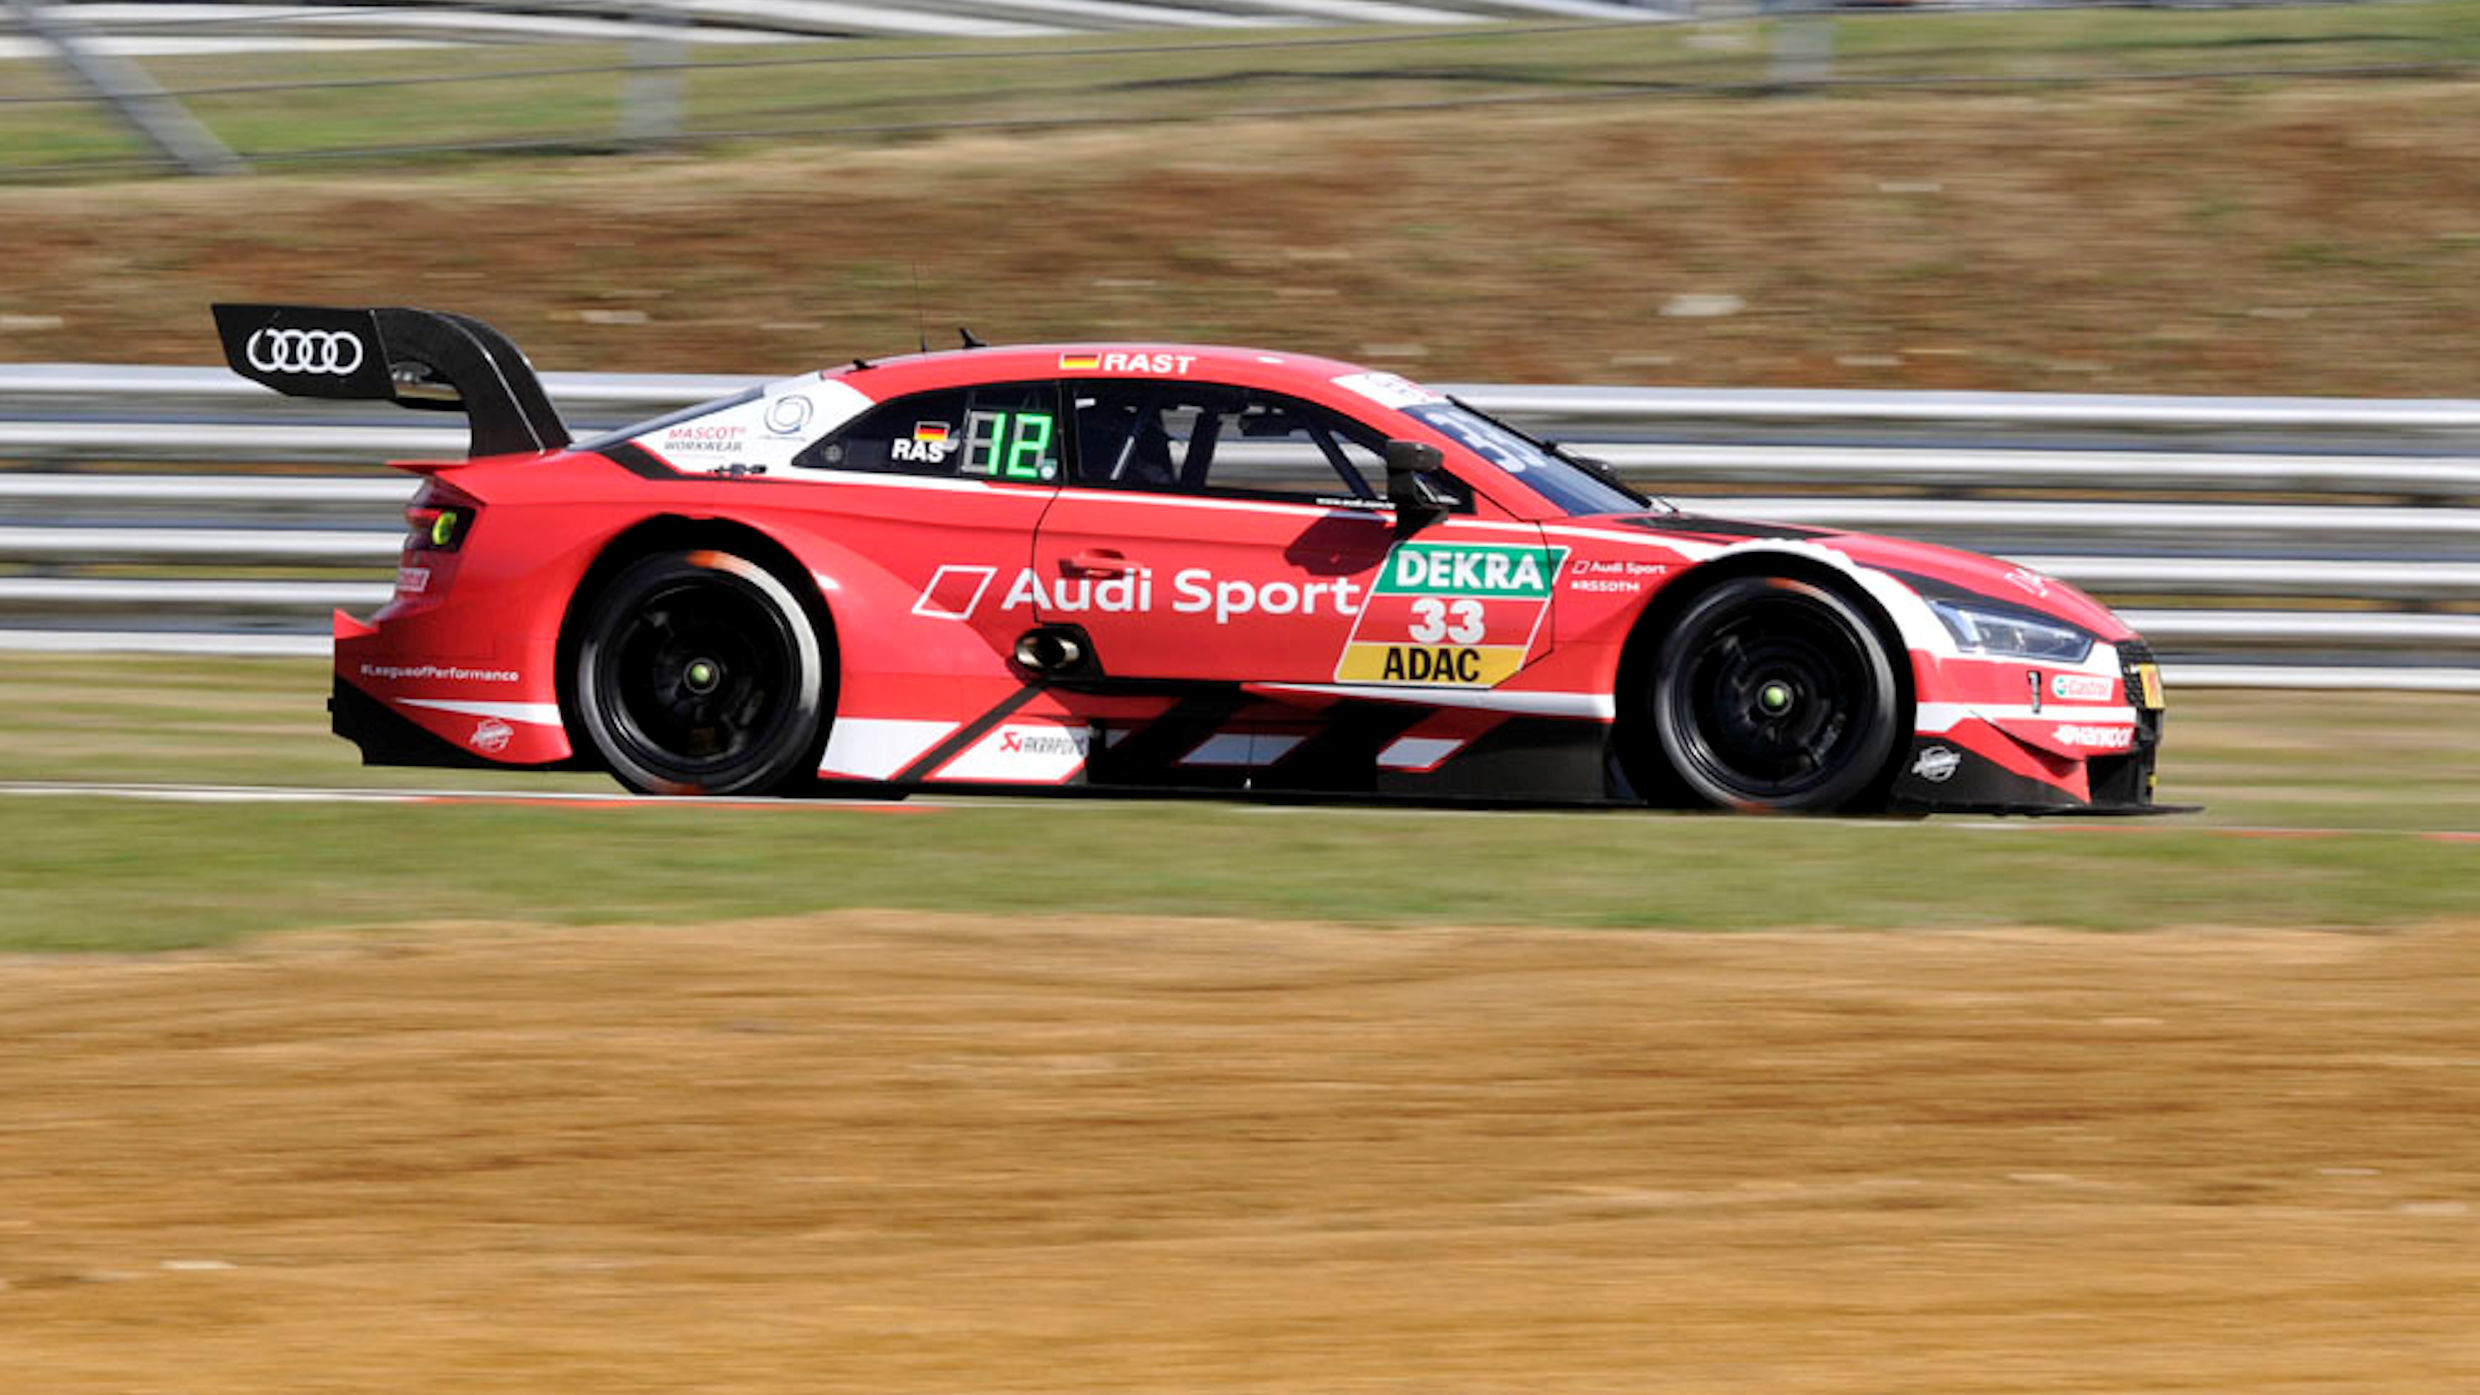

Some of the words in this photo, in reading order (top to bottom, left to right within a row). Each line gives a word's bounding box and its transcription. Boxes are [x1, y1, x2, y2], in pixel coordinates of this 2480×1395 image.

[1104, 353, 1197, 375] RAST
[664, 441, 743, 452] WORKWEAR
[1395, 551, 1545, 591] DEKRA
[1590, 561, 1624, 574] Audi
[1626, 562, 1667, 576] Sport
[1001, 565, 1152, 613] Audi
[1173, 569, 1361, 624] Sport
[1408, 598, 1486, 645] 33
[361, 663, 519, 682] #LeagueofPerformance
[1382, 647, 1481, 683] ADAC
